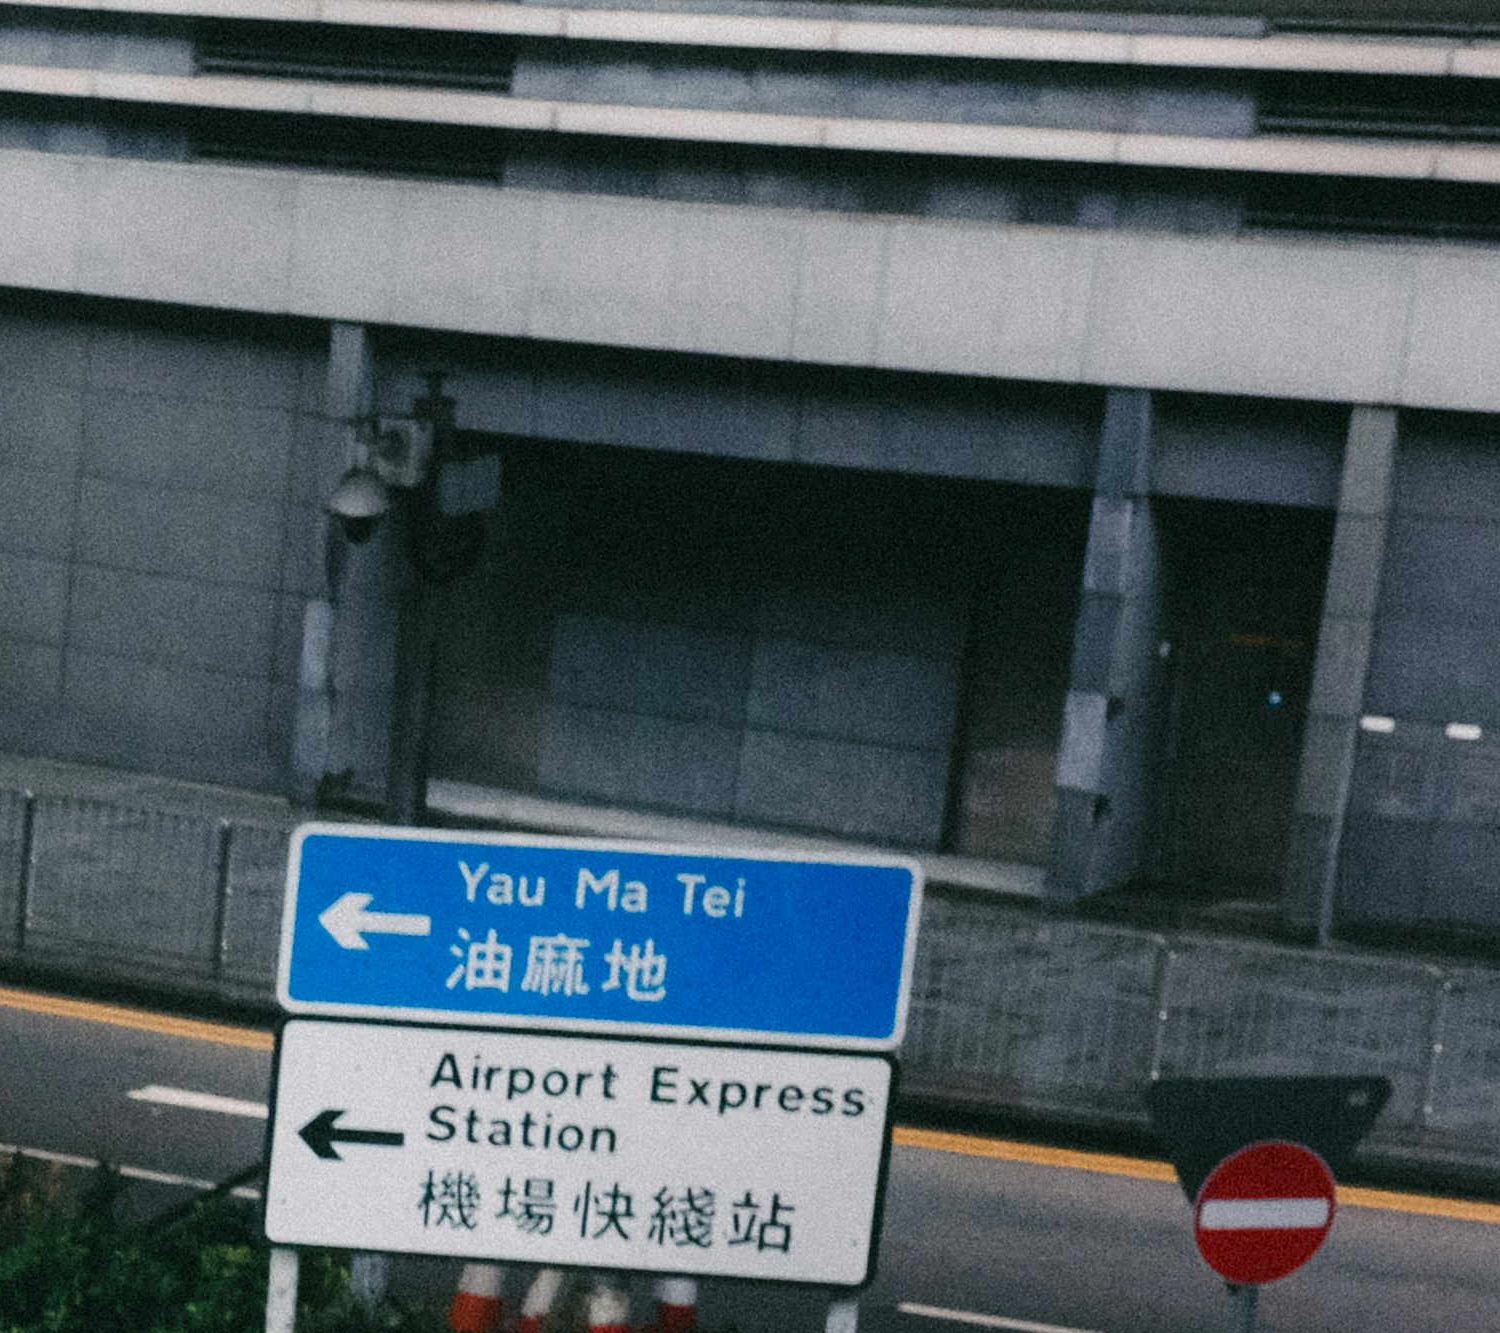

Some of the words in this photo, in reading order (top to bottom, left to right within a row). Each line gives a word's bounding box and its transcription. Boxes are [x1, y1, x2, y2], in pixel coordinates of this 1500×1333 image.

[457, 860, 546, 907] Yau
[574, 867, 649, 913] Ma
[676, 872, 747, 919] Tei
[445, 927, 668, 1003] 油麻地
[429, 1052, 619, 1101] Airport
[649, 1066, 867, 1118] Express
[425, 1104, 619, 1154] Station
[417, 1169, 797, 1254] 機場快綫站
